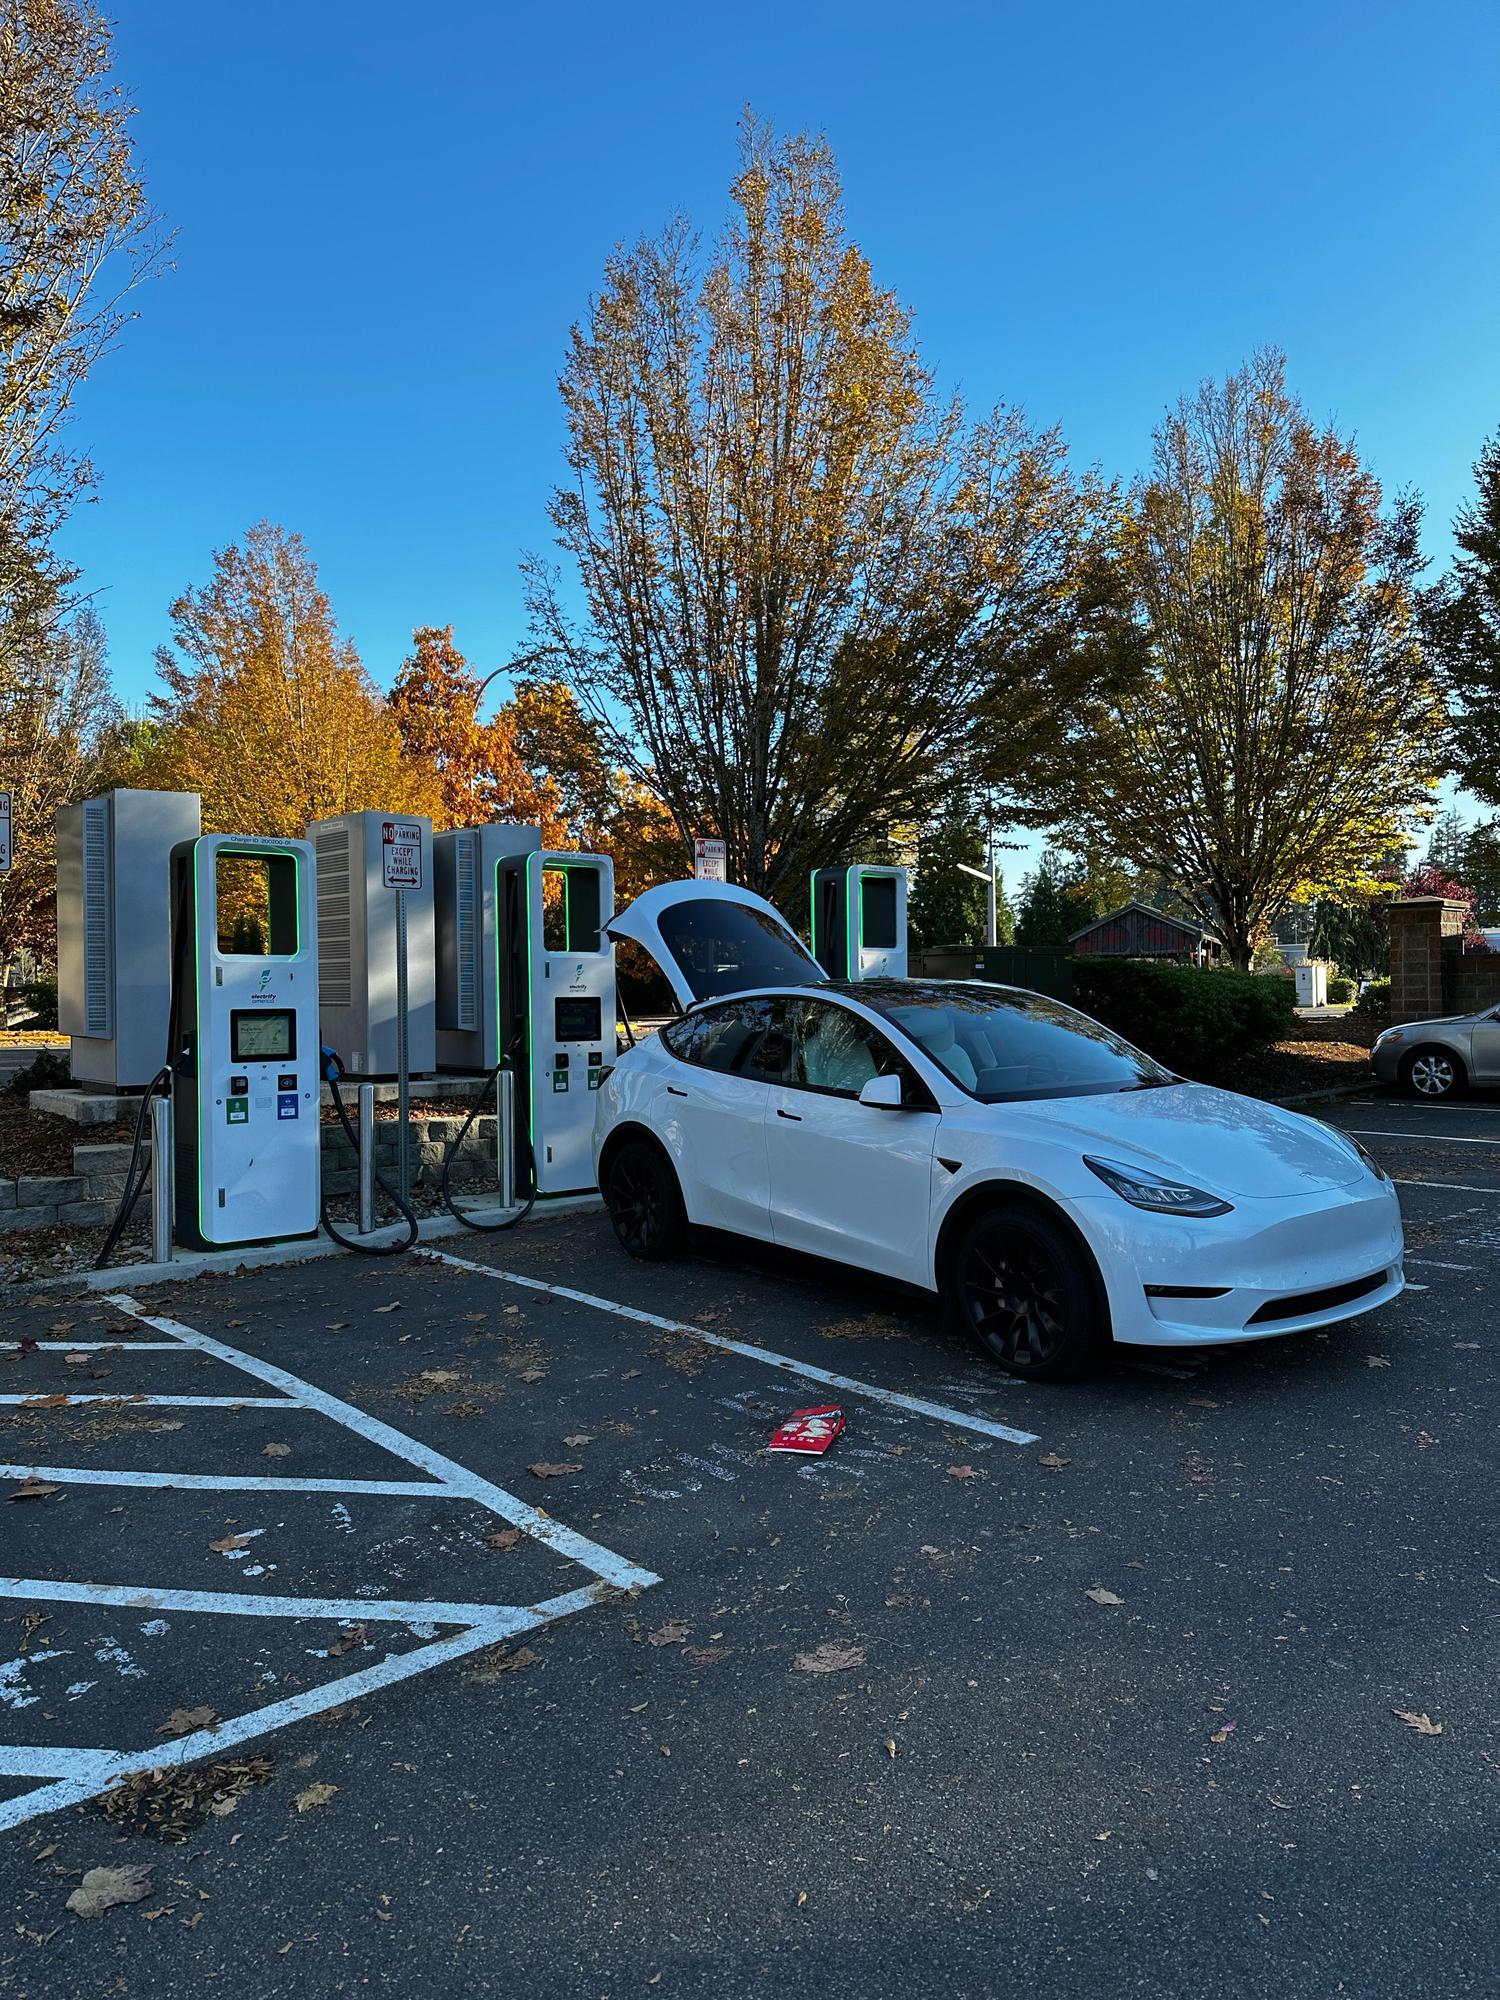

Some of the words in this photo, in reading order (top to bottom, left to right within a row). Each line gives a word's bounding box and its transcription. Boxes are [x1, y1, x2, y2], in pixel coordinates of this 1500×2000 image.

[383, 827, 394, 840] NO
[395, 830, 419, 840] PARKING
[391, 847, 414, 857] EXCEPT
[697, 843, 705, 855] NO
[705, 845, 724, 853] PARKING
[393, 856, 412, 866] WHILE
[386, 865, 419, 875] CHARGING
[704, 867, 719, 876] WHILE
